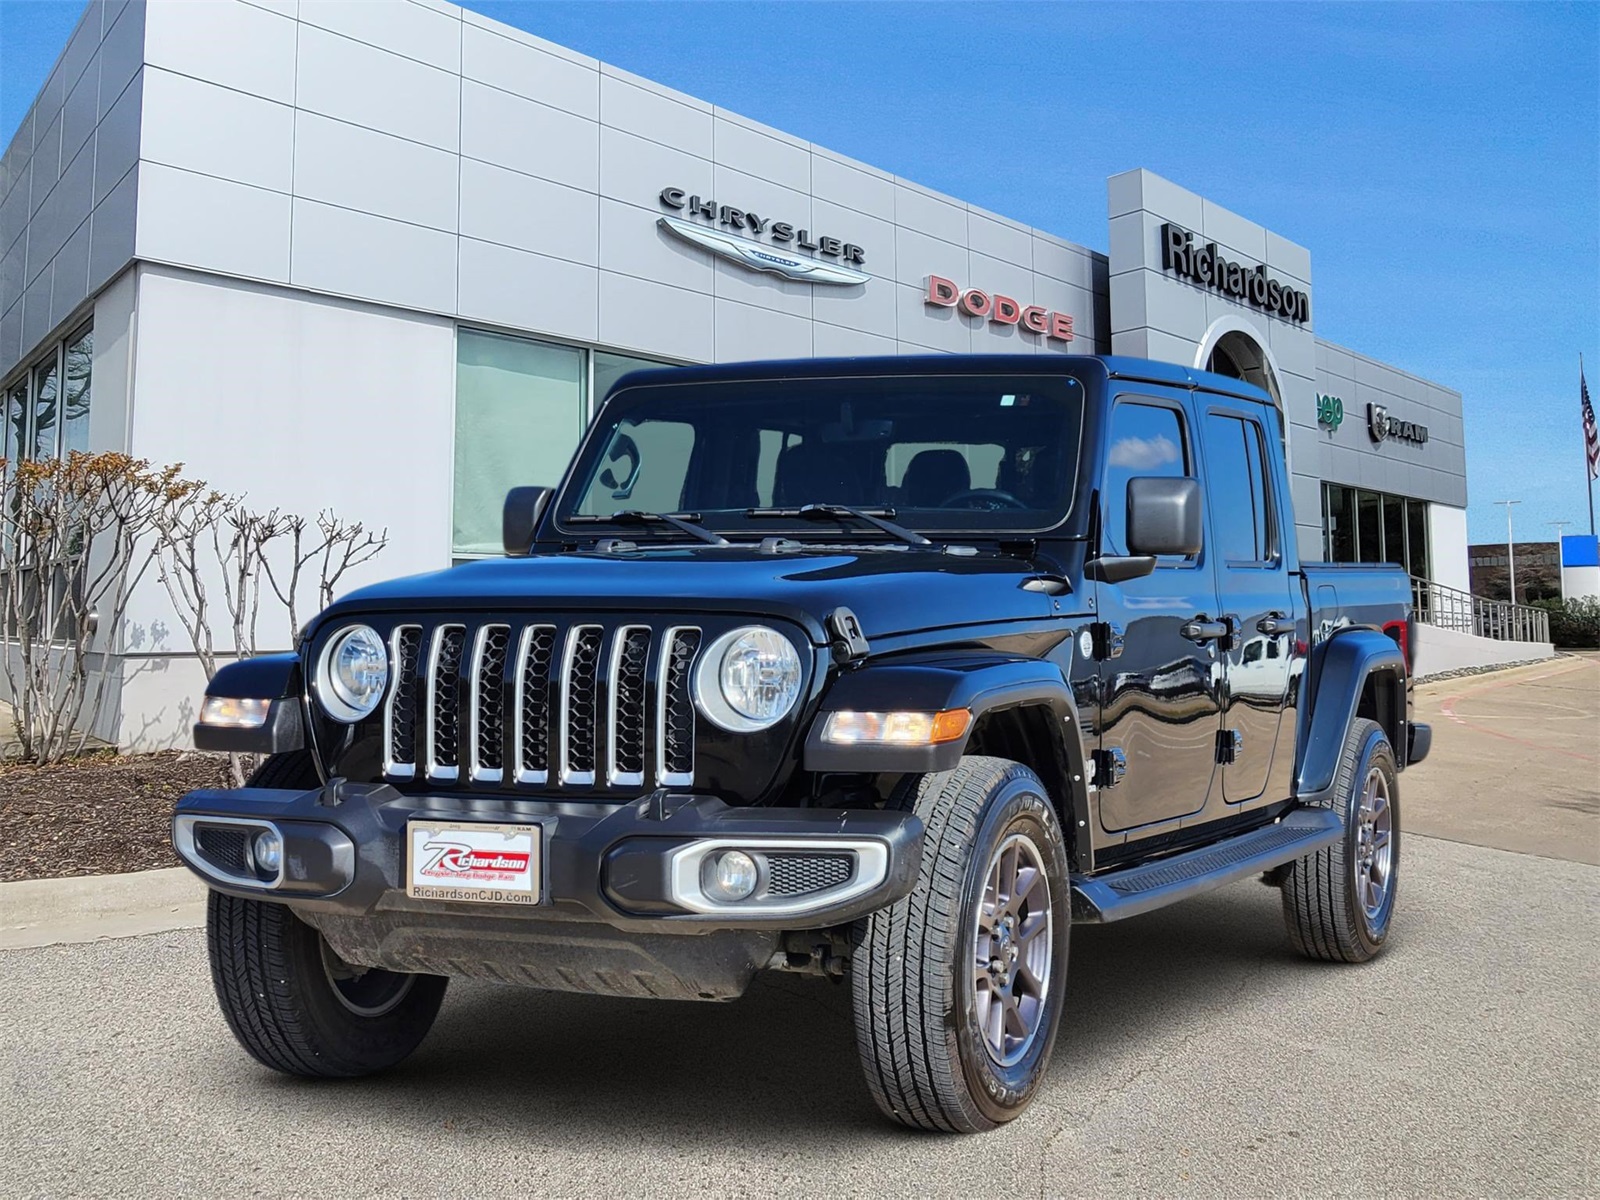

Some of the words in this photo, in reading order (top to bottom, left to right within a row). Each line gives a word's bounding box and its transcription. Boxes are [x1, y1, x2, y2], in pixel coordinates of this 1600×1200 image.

[660, 187, 866, 263] CHRYSLER
[754, 251, 797, 266] CHRYSLER
[1161, 223, 1310, 323] Richardson
[923, 274, 1074, 342] DODGE
[1388, 416, 1429, 443] RAM
[420, 841, 526, 875] Richardson
[413, 886, 532, 903] RichardsonCJD.com
